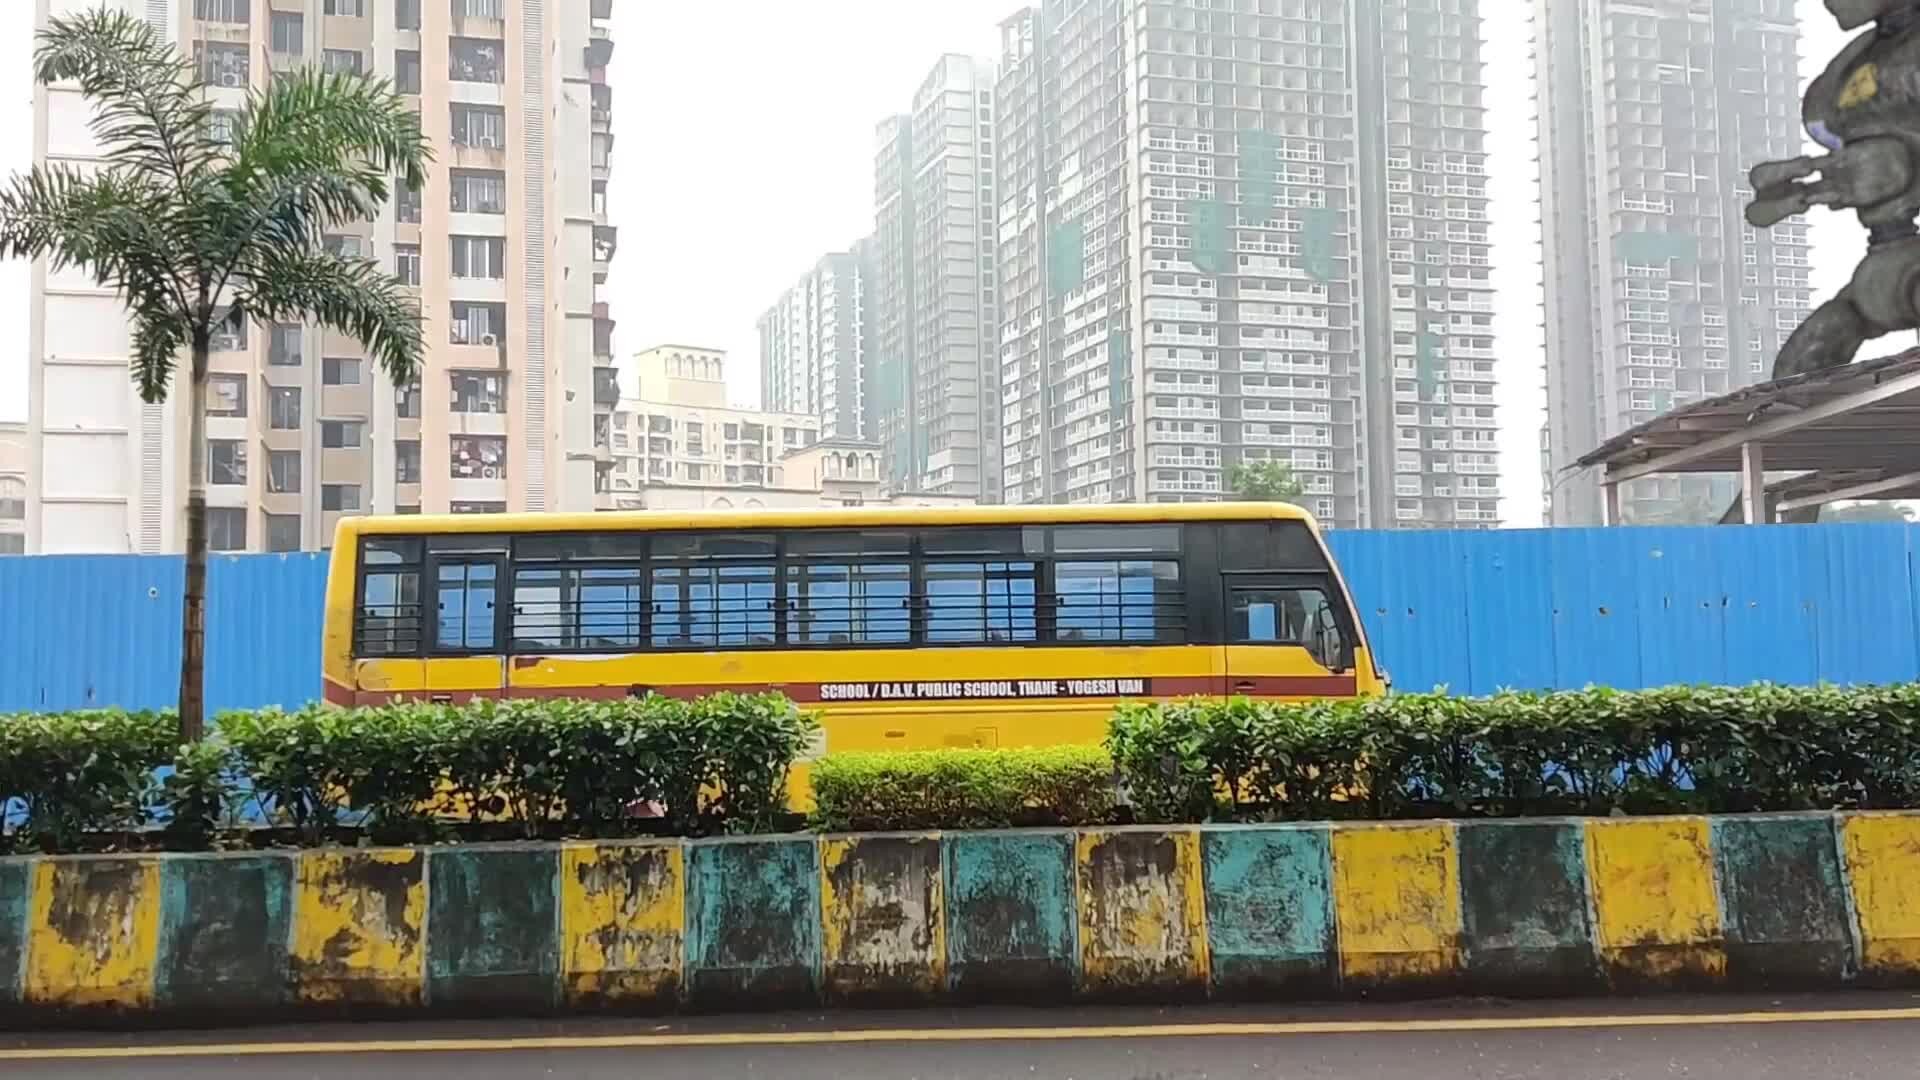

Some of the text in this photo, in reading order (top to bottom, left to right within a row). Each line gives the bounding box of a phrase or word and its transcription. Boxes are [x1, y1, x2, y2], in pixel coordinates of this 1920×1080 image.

[820, 684, 870, 699] SCHOOL
[872, 684, 879, 698] /
[881, 683, 915, 698] D.A.V.
[917, 682, 962, 697] PUBLIC
[1018, 681, 1058, 696] THANE
[1067, 680, 1116, 695] YOGESH
[1117, 679, 1144, 694] VAN
